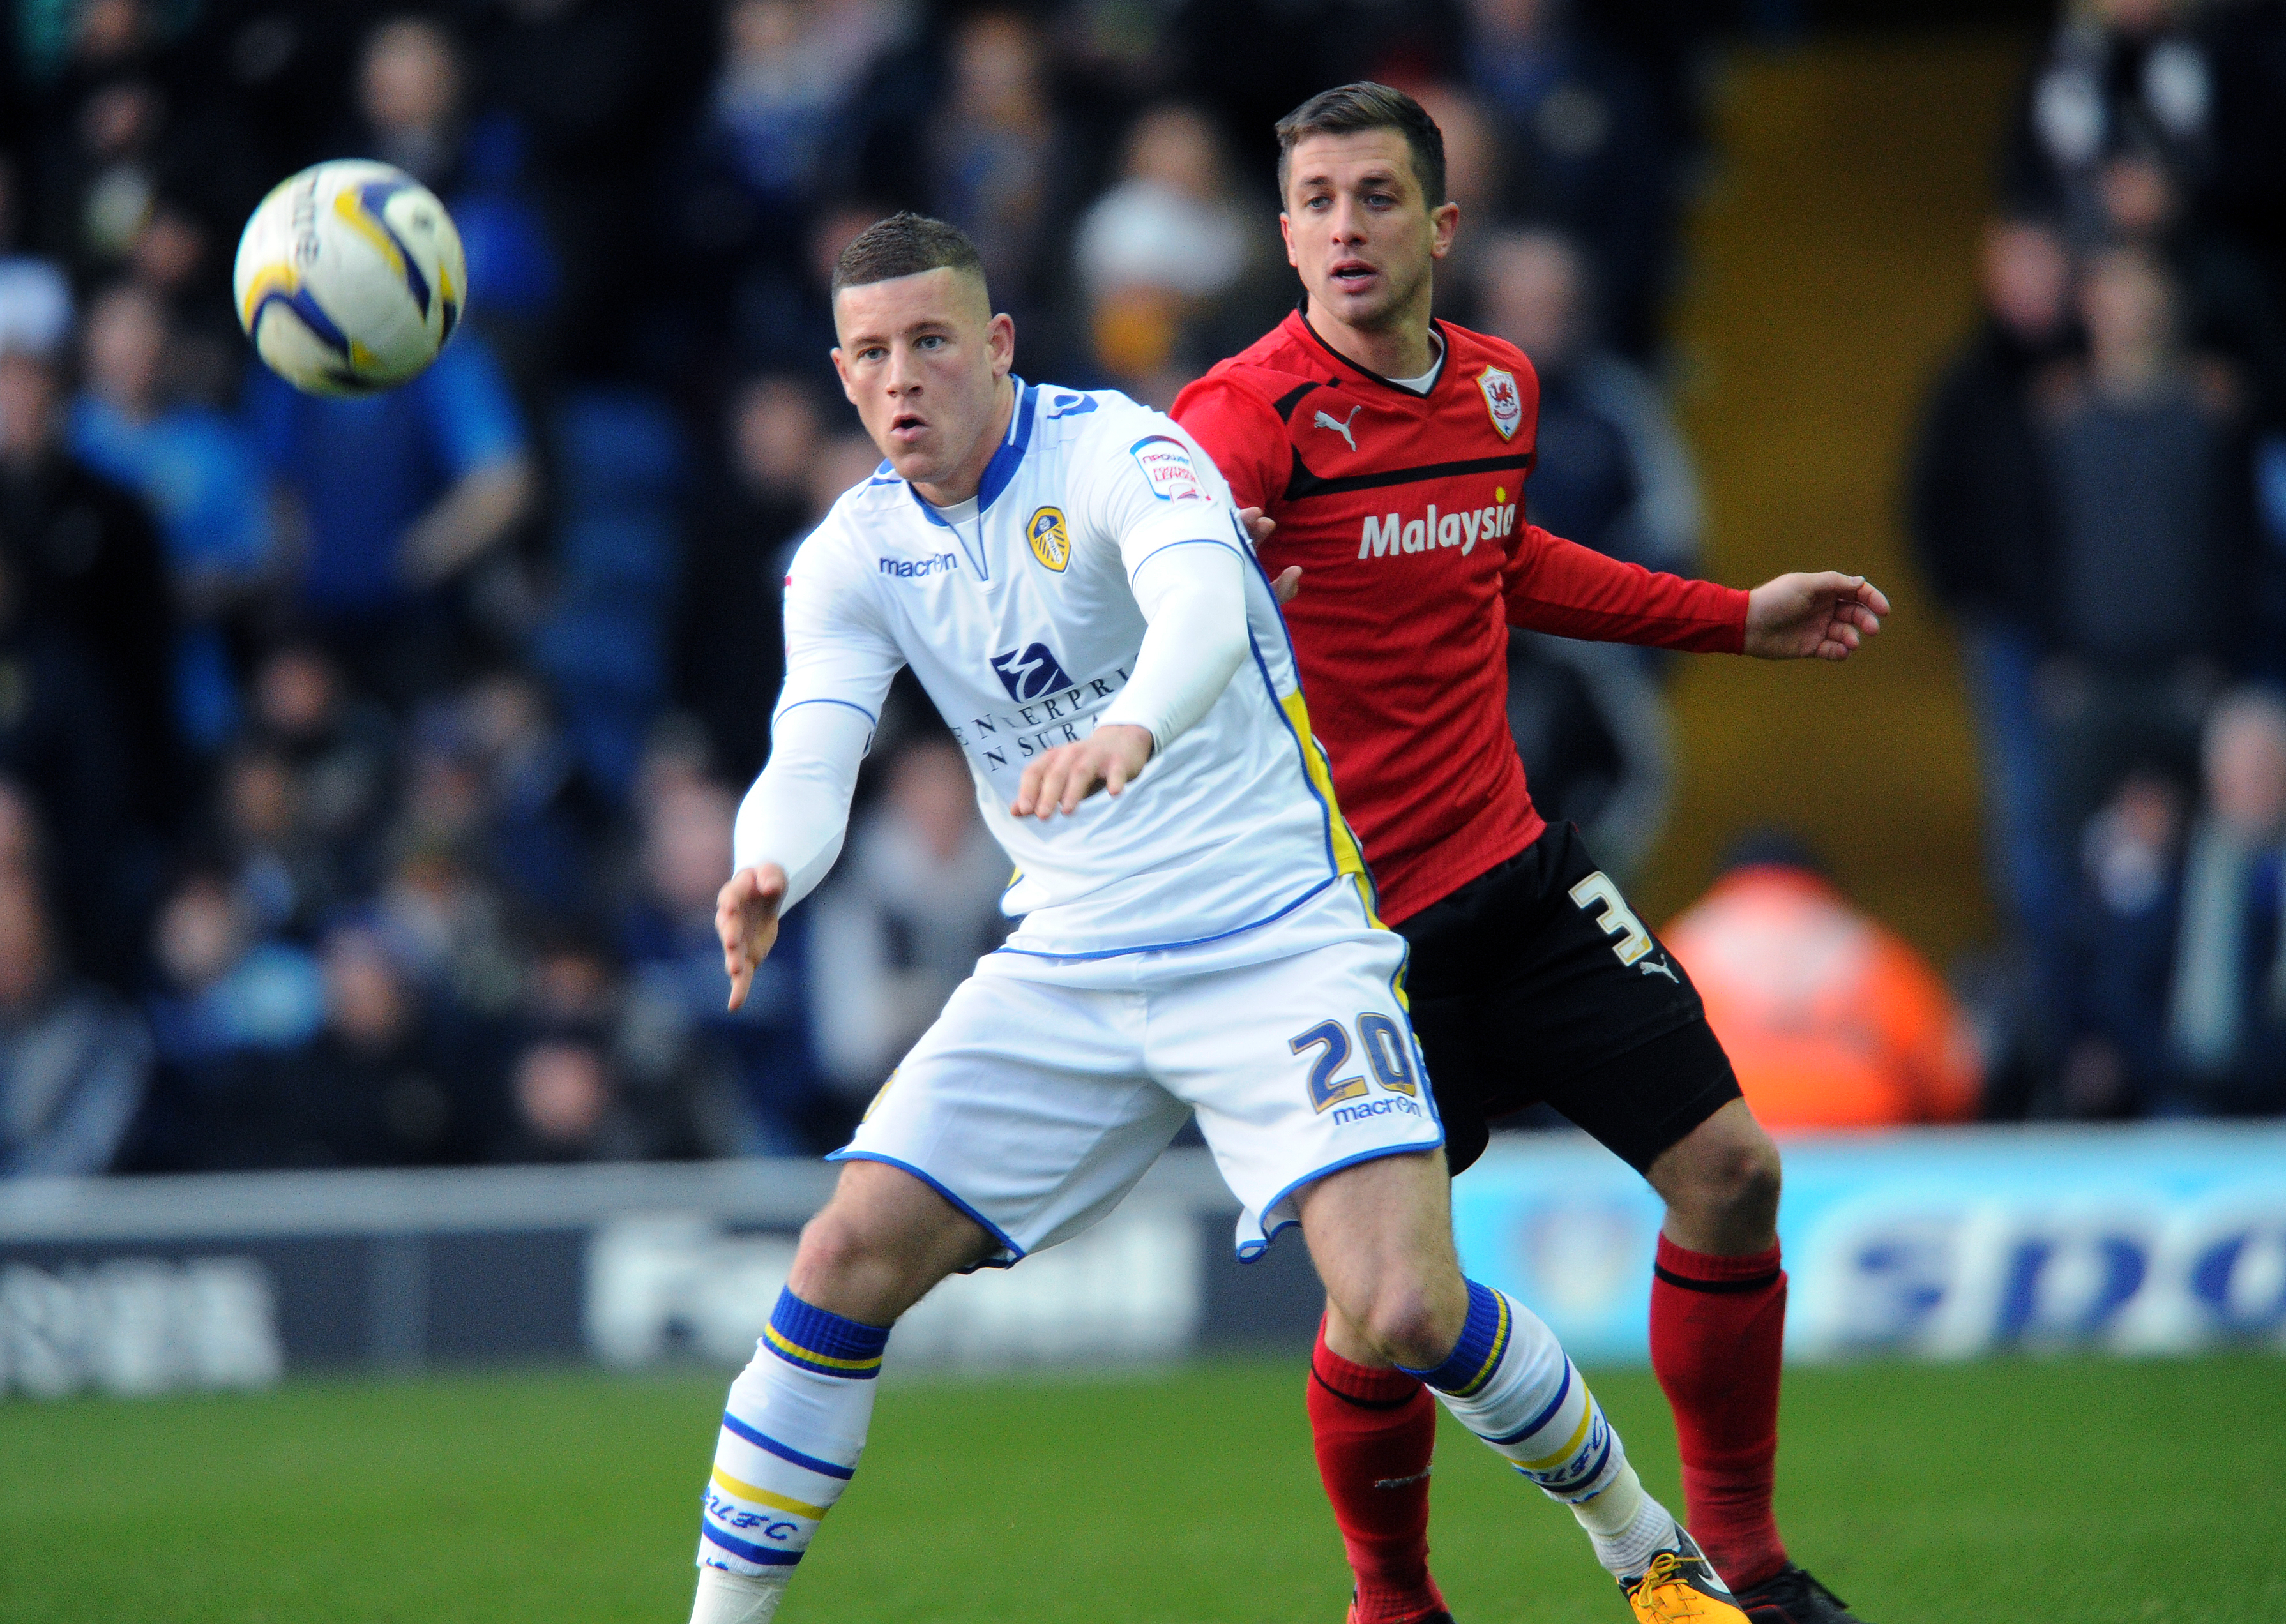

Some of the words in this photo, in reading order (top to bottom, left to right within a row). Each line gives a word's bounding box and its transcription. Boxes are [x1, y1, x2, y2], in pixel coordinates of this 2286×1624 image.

[1358, 486, 1516, 560] Malaysia
[879, 552, 958, 577] macron
[1568, 870, 1653, 966] 3
[1287, 1012, 1416, 1115] 20
[1333, 1095, 1422, 1125] macron
